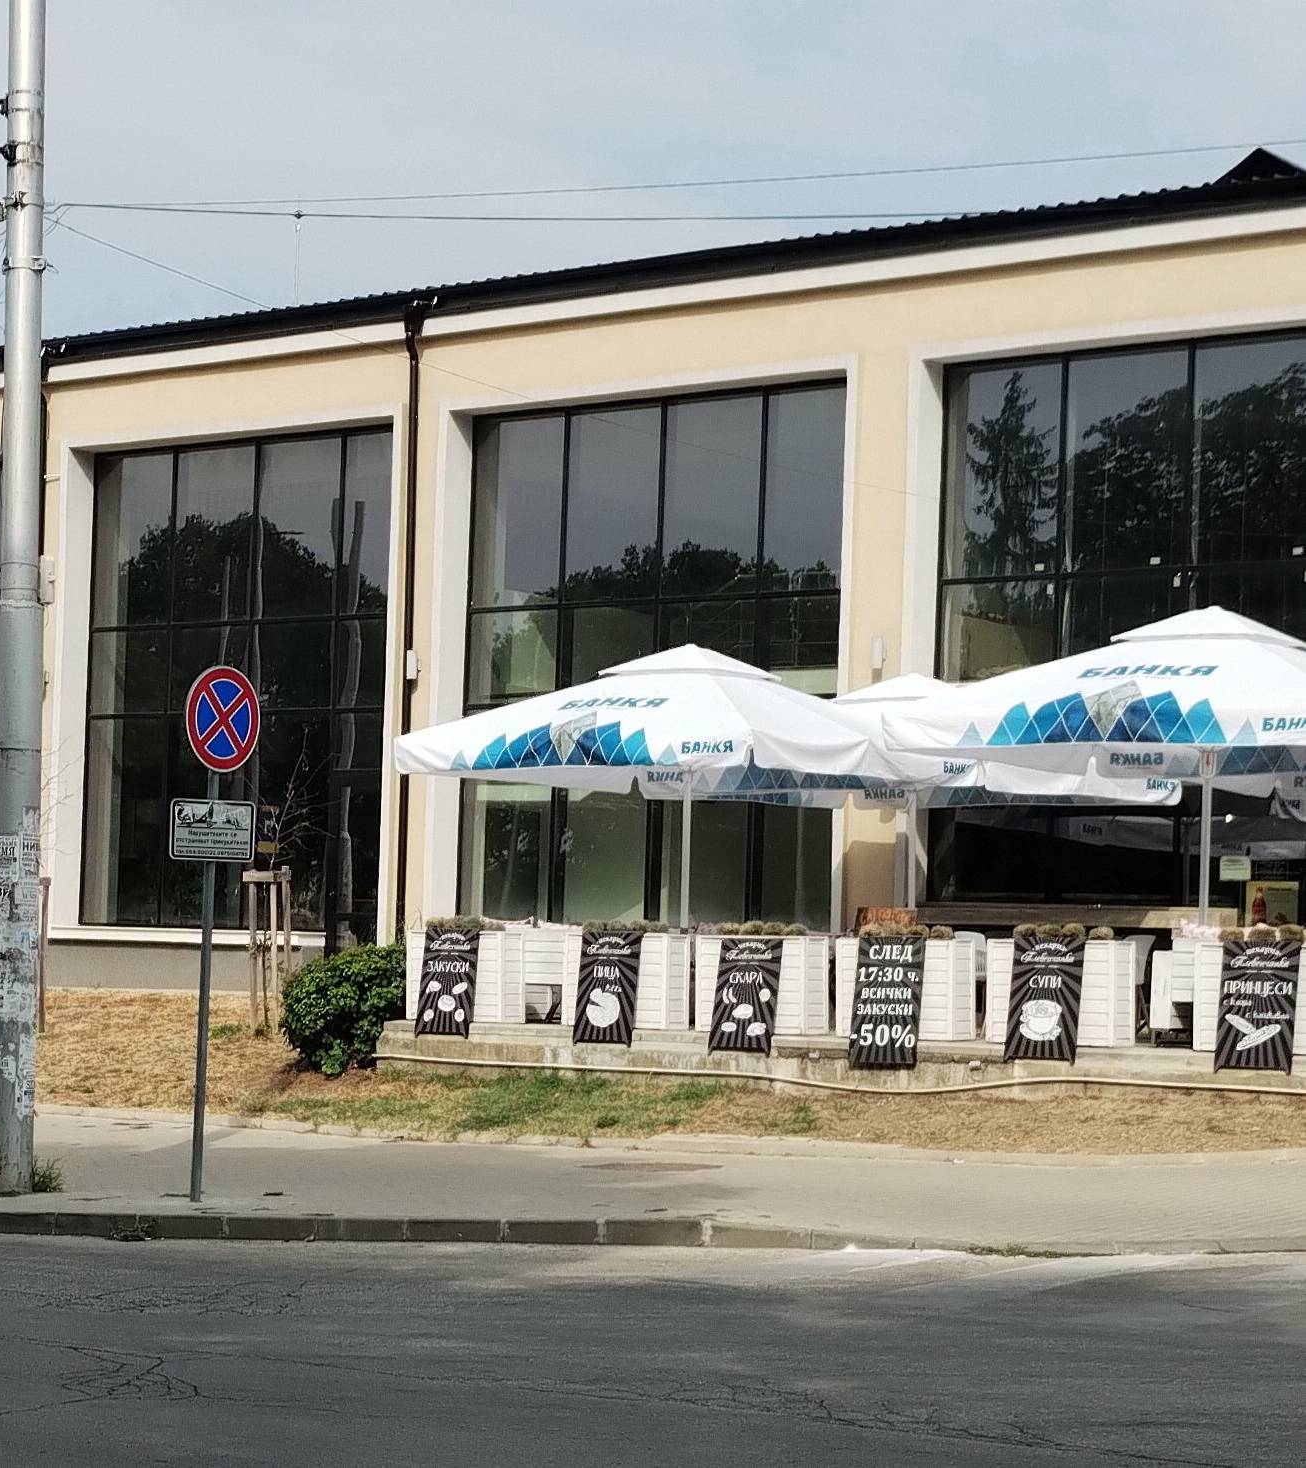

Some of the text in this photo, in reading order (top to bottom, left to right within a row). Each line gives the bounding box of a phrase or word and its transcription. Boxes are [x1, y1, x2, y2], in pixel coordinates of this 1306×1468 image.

[1077, 664, 1219, 679] БАНКЯ
[558, 697, 669, 710] БАНКЯ
[681, 740, 733, 754] БАНКЯ
[869, 944, 913, 963] СЛЕД
[427, 960, 470, 973] ЗАКУСКИ
[594, 965, 620, 980] ПИЦА
[729, 971, 763, 985] СКАРА
[858, 966, 919, 982] 17:30 ч.
[1029, 975, 1062, 988] СУПИ
[1224, 980, 1293, 997] ПРИНЦЕСИ
[860, 987, 912, 999] ВСИЧКИ
[856, 1003, 913, 1015] ЗАКУСКИ
[850, 1023, 916, 1048] -50%
